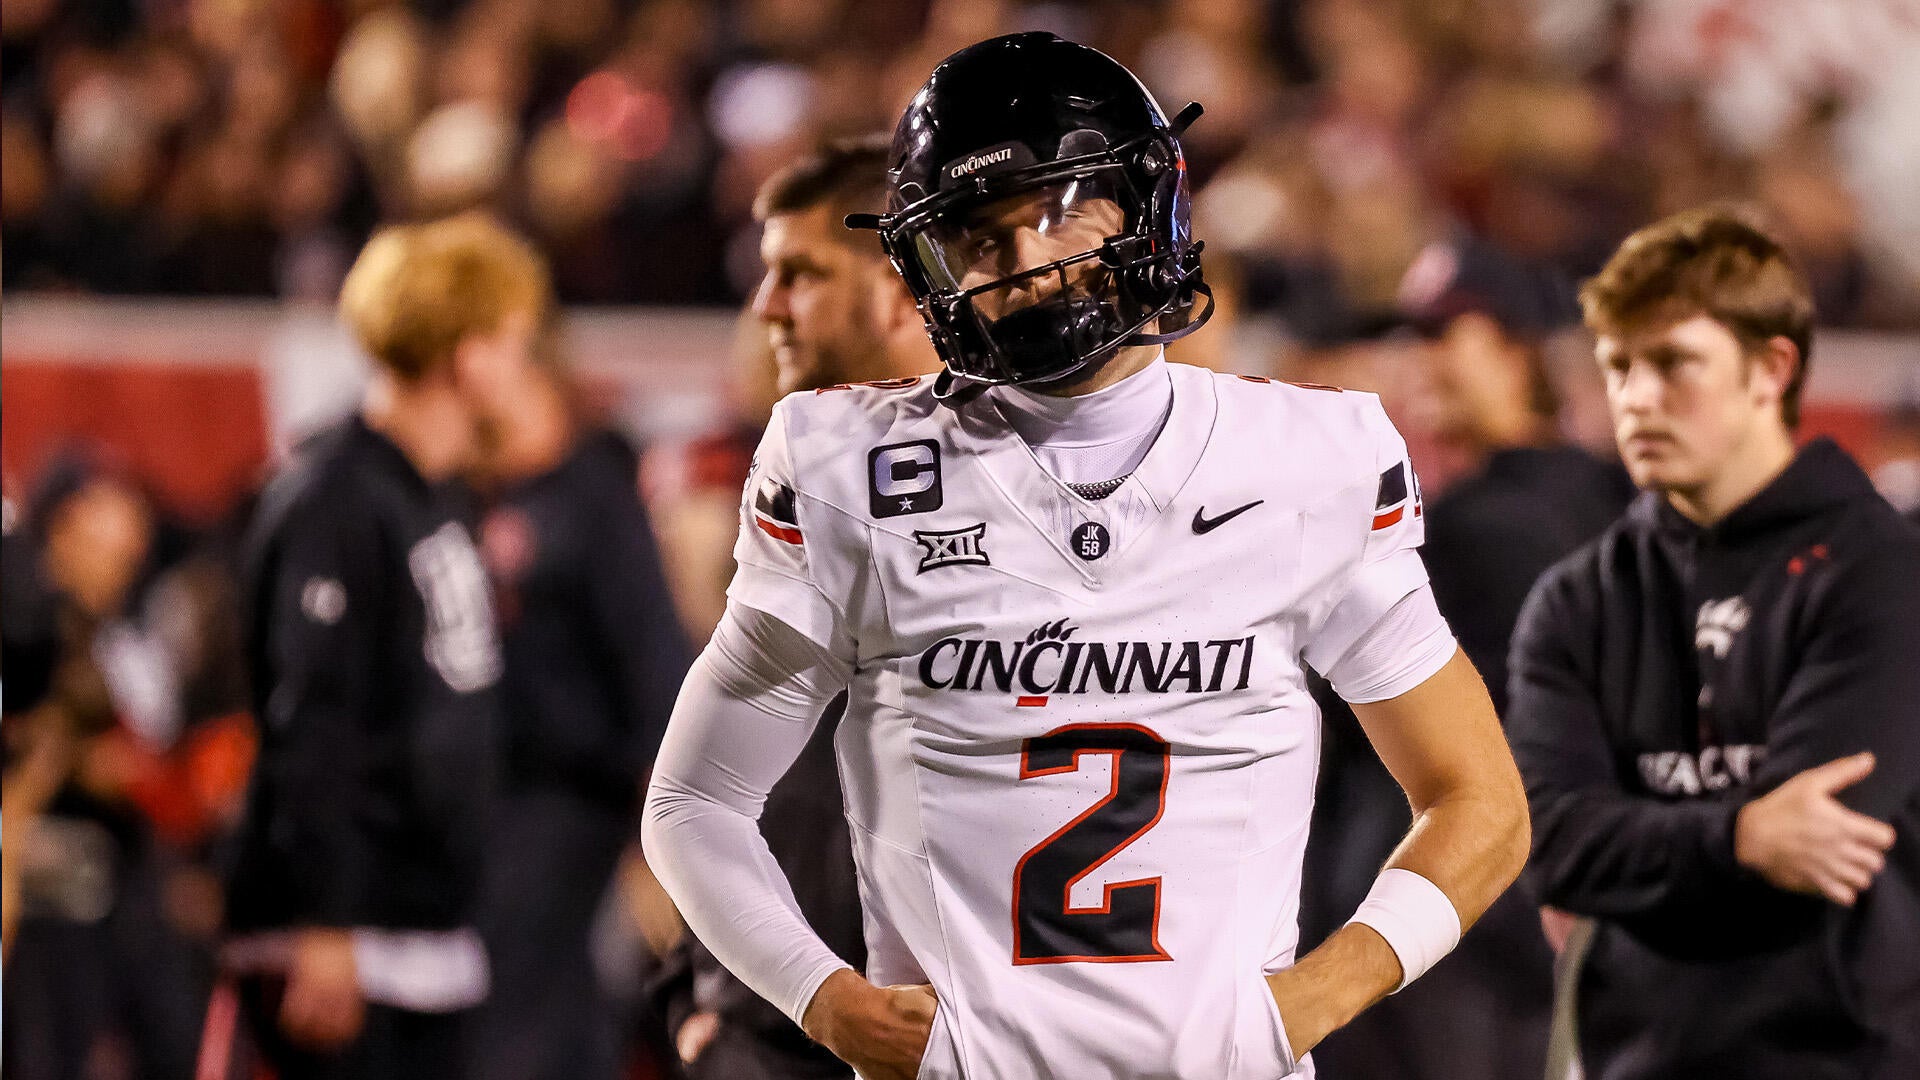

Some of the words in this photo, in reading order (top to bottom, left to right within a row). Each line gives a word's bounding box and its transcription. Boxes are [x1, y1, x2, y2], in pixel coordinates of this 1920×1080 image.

[951, 148, 1012, 178] CINCINNATI
[875, 444, 935, 497] C
[1081, 541, 1100, 556] 58
[1082, 525, 1099, 540] JK
[918, 634, 1256, 695] CINCINNATI
[1012, 722, 1174, 966] 2
